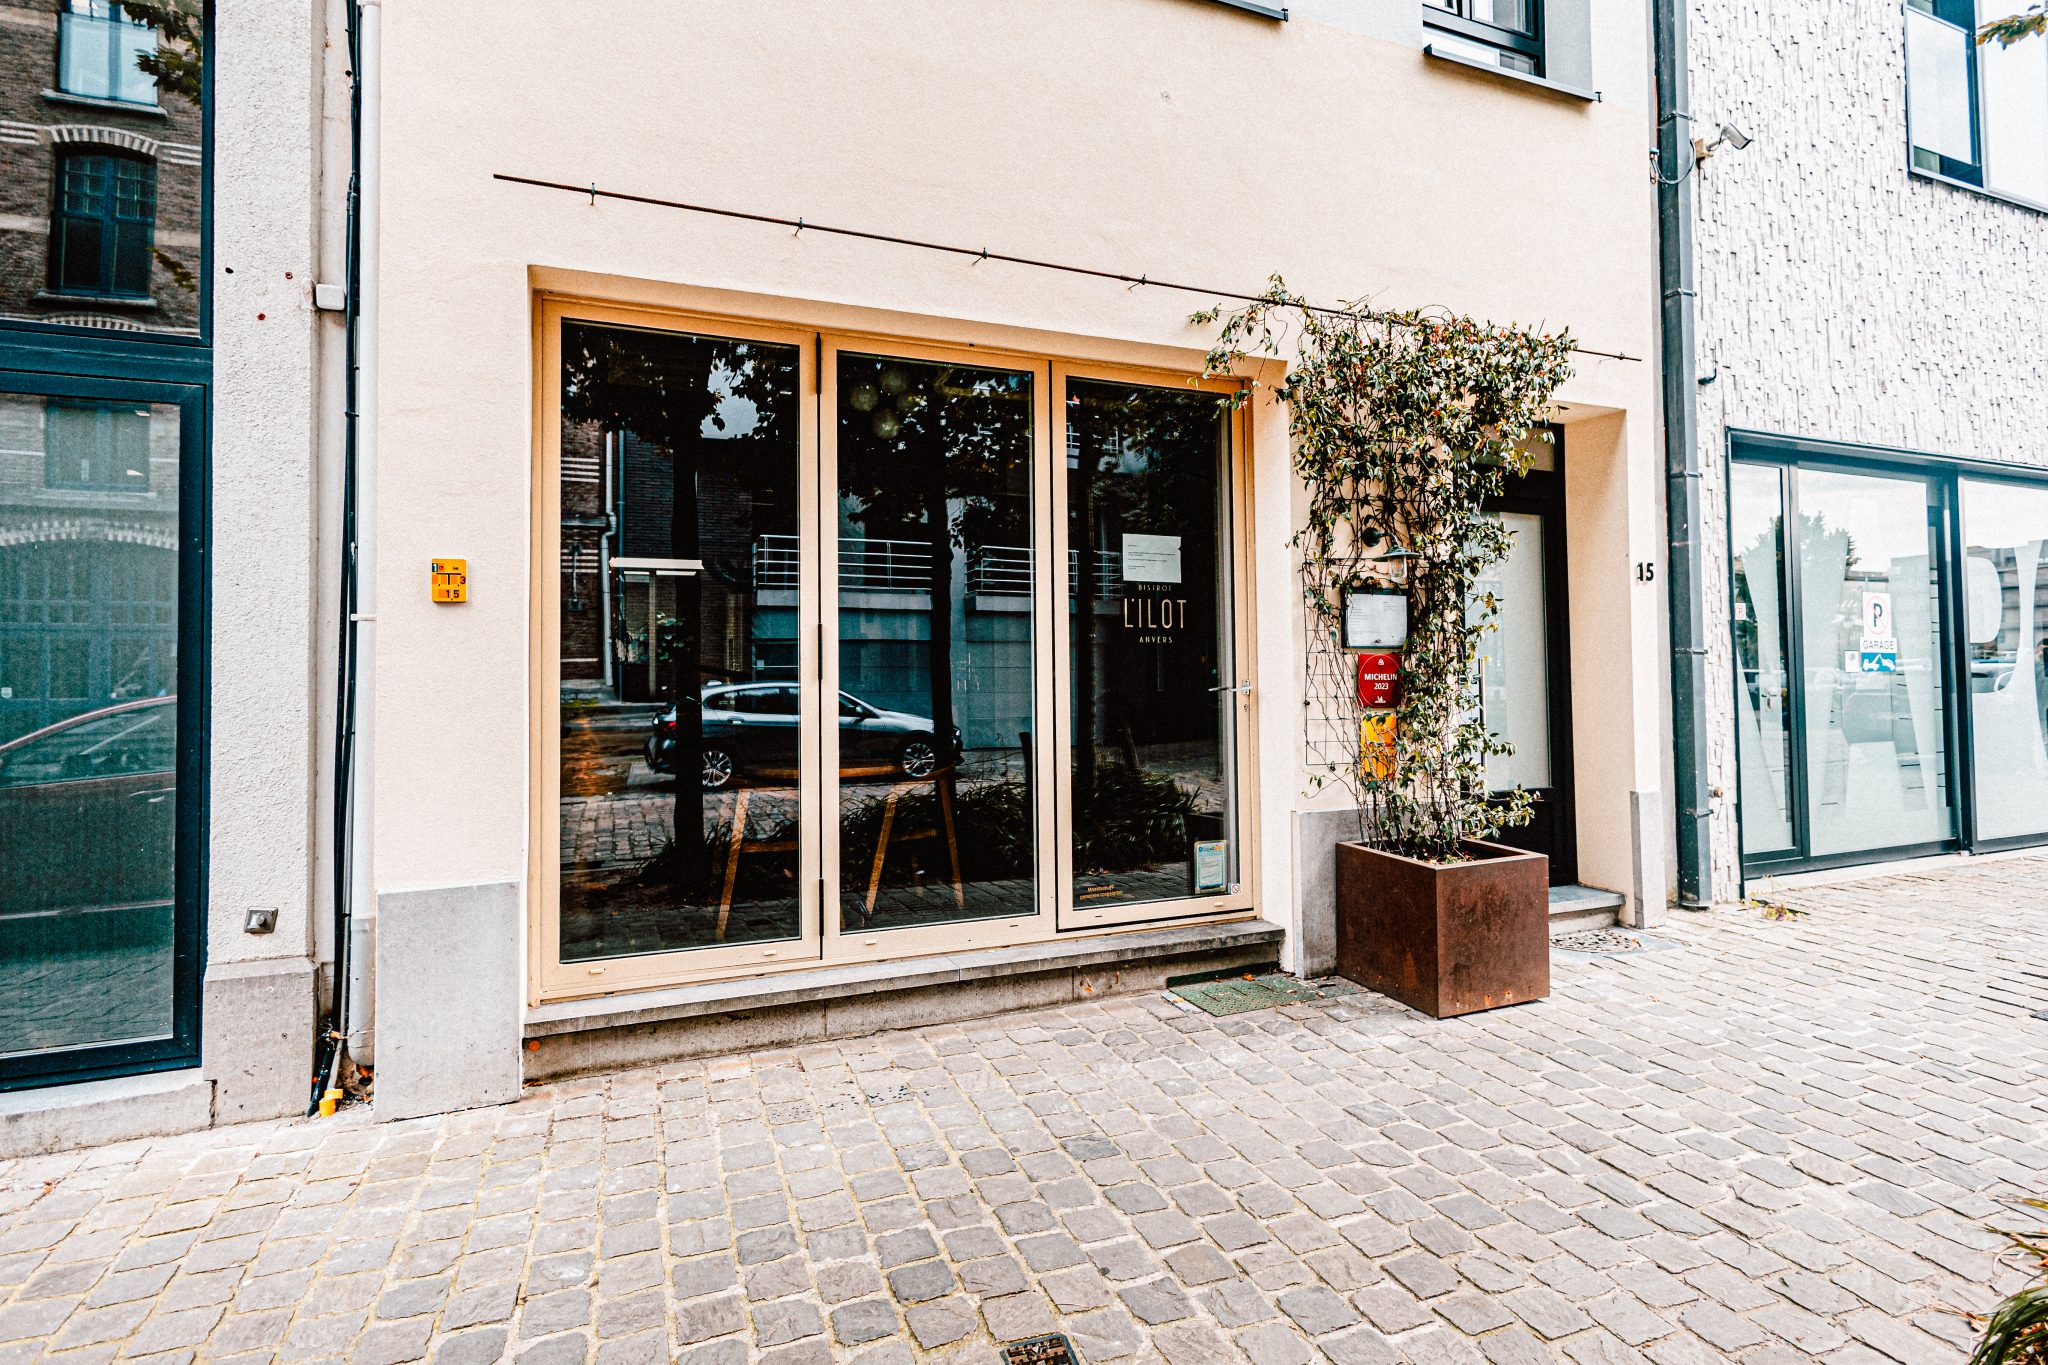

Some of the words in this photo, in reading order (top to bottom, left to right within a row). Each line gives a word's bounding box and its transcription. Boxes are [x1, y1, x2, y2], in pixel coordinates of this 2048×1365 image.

[1637, 562, 1654, 581] 15
[1138, 584, 1172, 592] BISTROT
[1124, 598, 1187, 629] L'ILOT
[1139, 636, 1173, 644] ANVERS
[1863, 640, 1895, 650] GARAGE
[1364, 673, 1398, 681] MICHELIN
